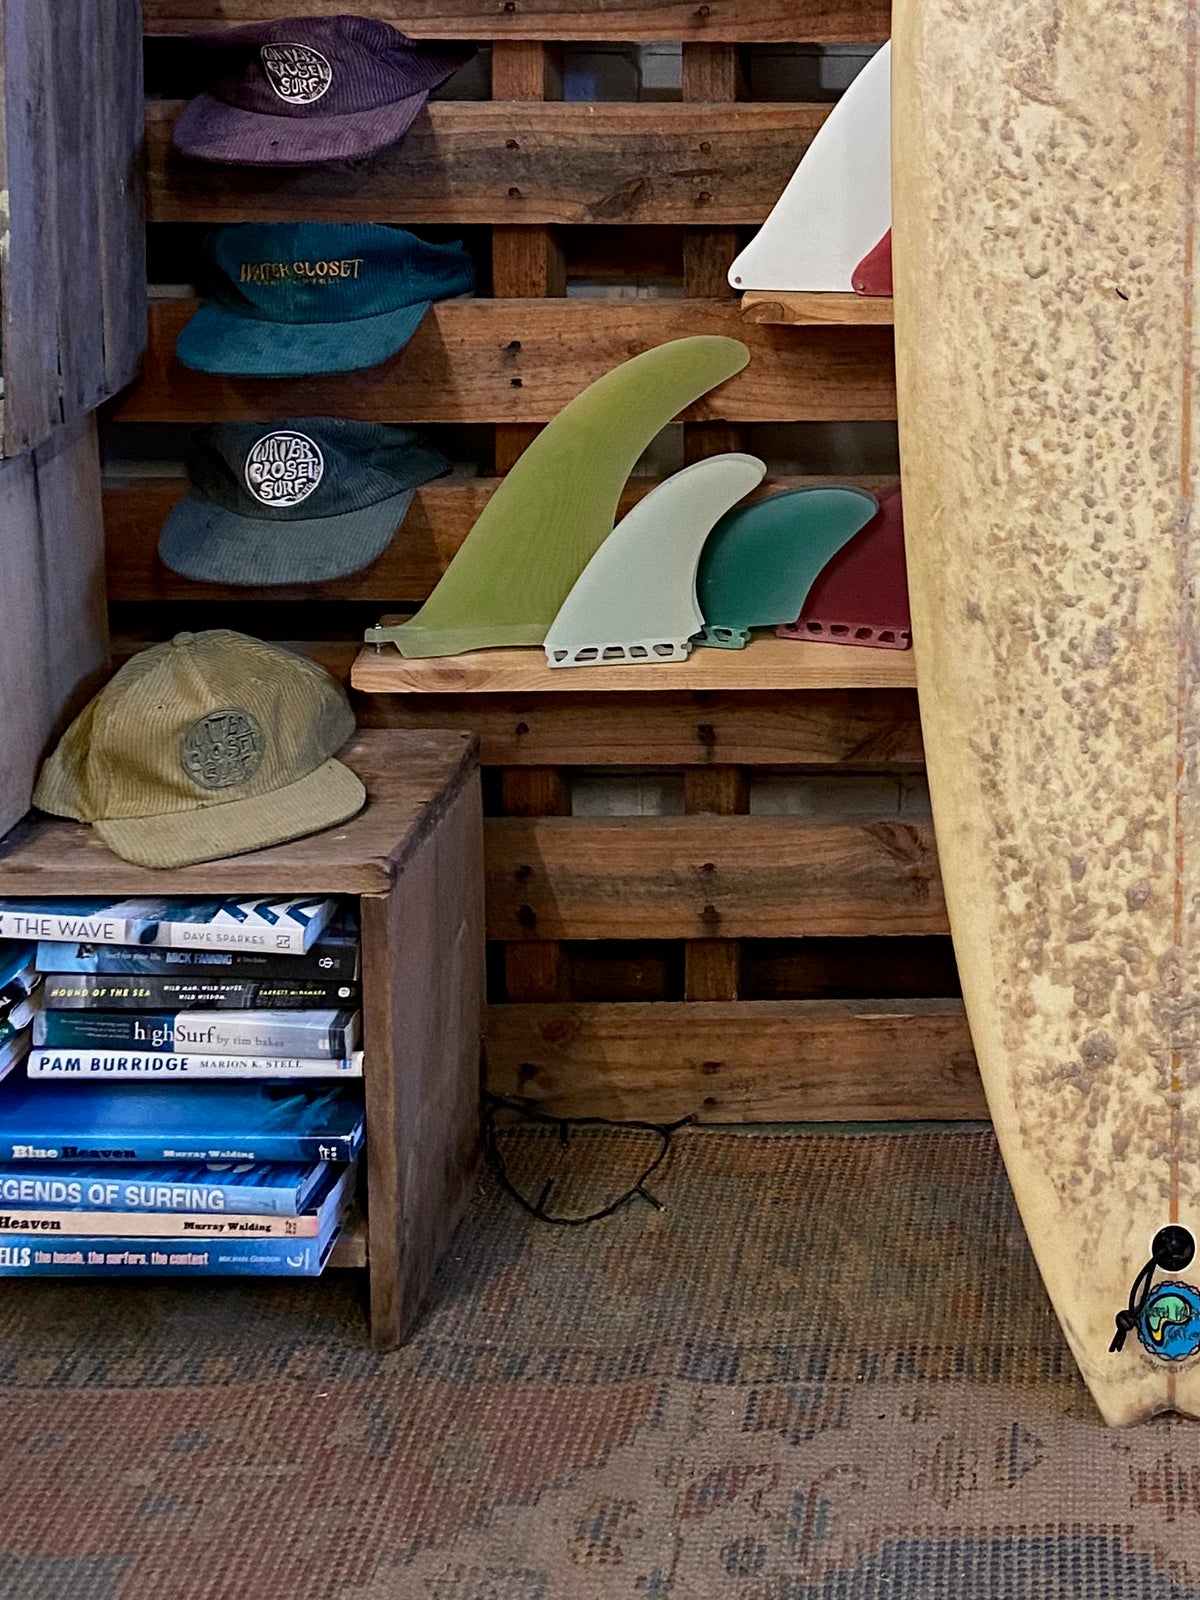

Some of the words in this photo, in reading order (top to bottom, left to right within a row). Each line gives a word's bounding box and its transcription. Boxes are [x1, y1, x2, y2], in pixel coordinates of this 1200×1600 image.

[279, 76, 320, 95] SURF
[293, 258, 364, 279] CLOSET
[252, 436, 314, 462] WATER
[249, 458, 318, 483] CLOSET
[259, 478, 307, 499] SURF
[13, 917, 51, 936] THE
[58, 920, 114, 940] WAVE
[183, 931, 212, 942] DAVE
[217, 933, 265, 945] SPARKES
[166, 952, 191, 964] MICK
[92, 988, 106, 997] OF
[110, 988, 129, 997] THE
[132, 988, 151, 997] SEA
[216, 1033, 230, 1046] by
[39, 1056, 82, 1072] PAM
[90, 1056, 189, 1072] BURRIDGE
[200, 1060, 248, 1069] MARION
[266, 1061, 303, 1069] STELL
[12, 1145, 58, 1160] Blue
[62, 1146, 137, 1160] Heaven
[163, 1150, 206, 1160] Murray
[208, 1150, 255, 1160] Walding
[0, 1179, 82, 1204] GENDS
[88, 1184, 119, 1205] OF
[125, 1187, 225, 1210] SURFING
[0, 1215, 61, 1230] Heaven
[184, 1221, 224, 1232] Murray
[228, 1222, 272, 1233] Walding
